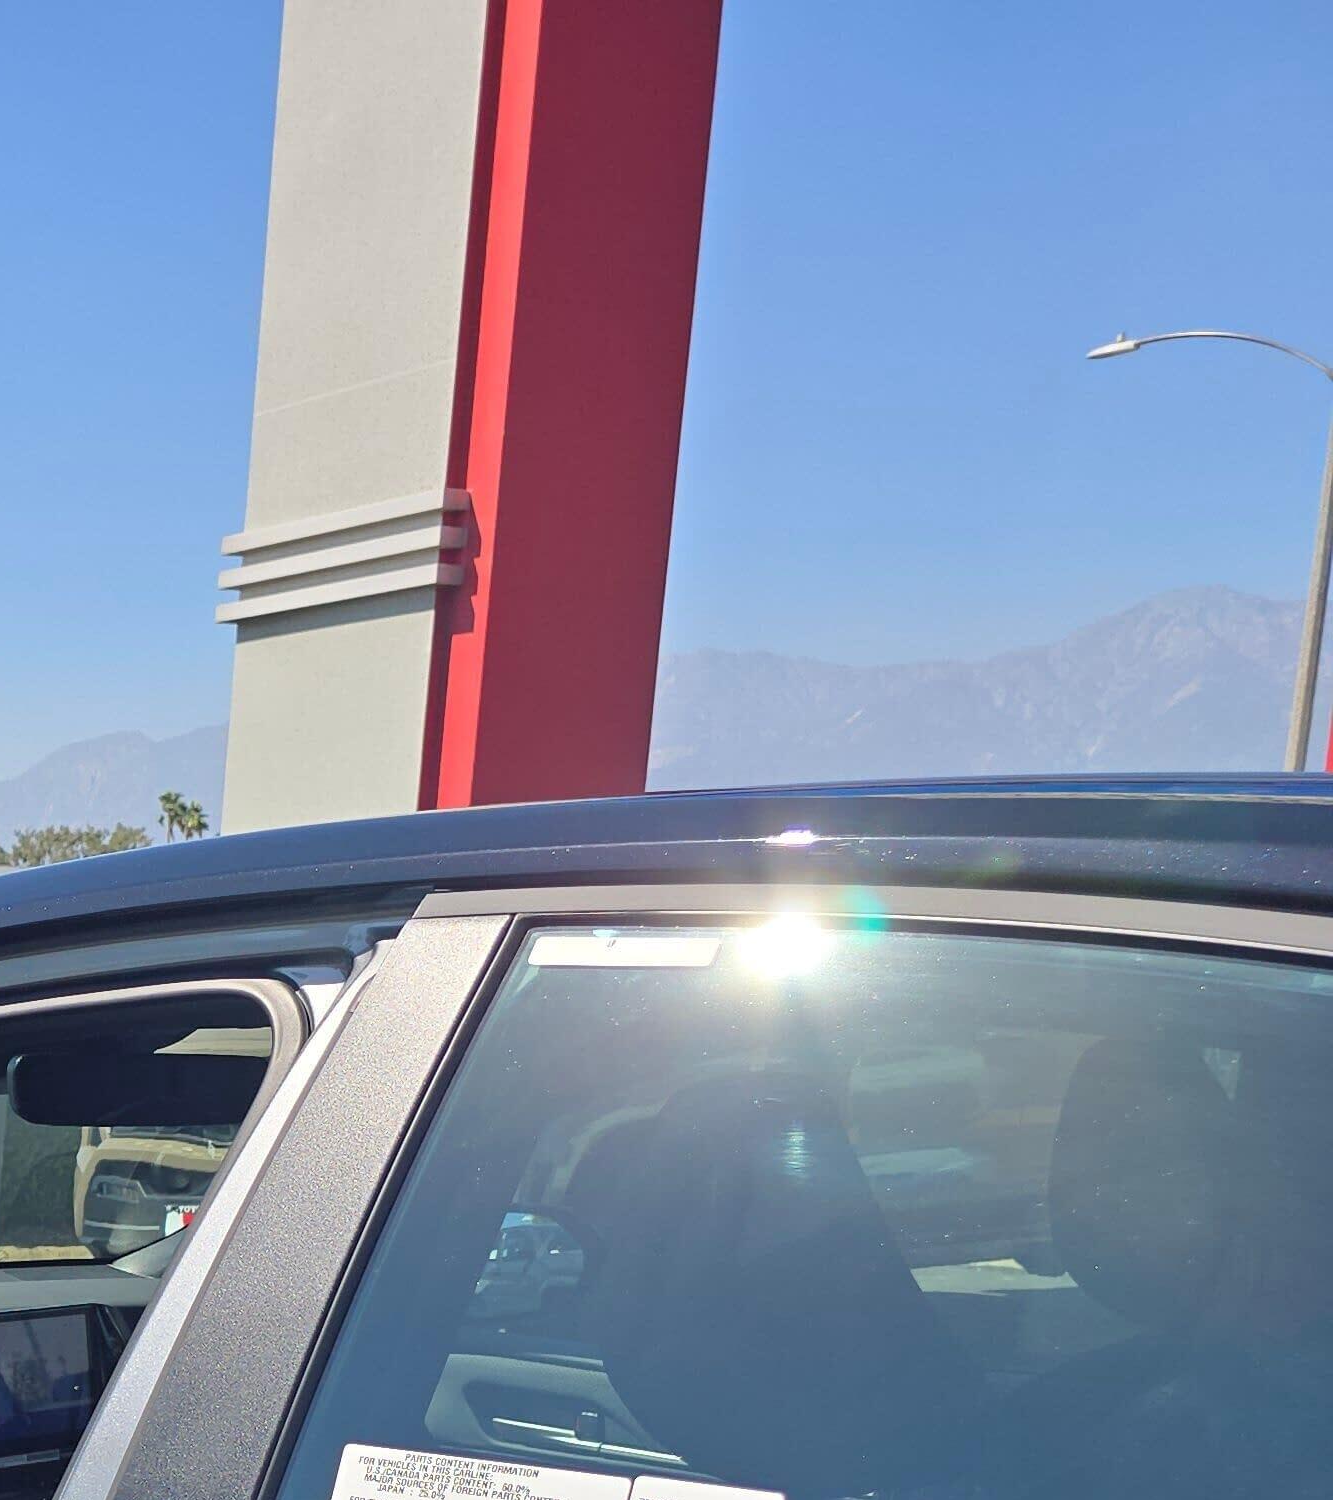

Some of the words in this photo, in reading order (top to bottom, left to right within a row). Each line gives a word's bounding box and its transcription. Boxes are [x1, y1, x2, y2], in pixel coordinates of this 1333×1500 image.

[359, 1456, 375, 1465] FOR
[378, 1459, 416, 1471] VEHICLES
[419, 1464, 428, 1472] IN
[432, 1466, 450, 1475] THIS
[454, 1469, 493, 1480] CARLINE:
[405, 1454, 432, 1466] PARTS
[436, 1458, 474, 1471] CONTENT
[478, 1464, 539, 1478] INFORMATION
[364, 1474, 393, 1486] MAJOR
[395, 1478, 434, 1492] SOURCES
[438, 1483, 448, 1493] OF
[451, 1484, 488, 1497] FOREIGN
[377, 1484, 405, 1494] JAPAN
[422, 1473, 451, 1485] PARTS
[454, 1477, 496, 1489] CONTENT:
